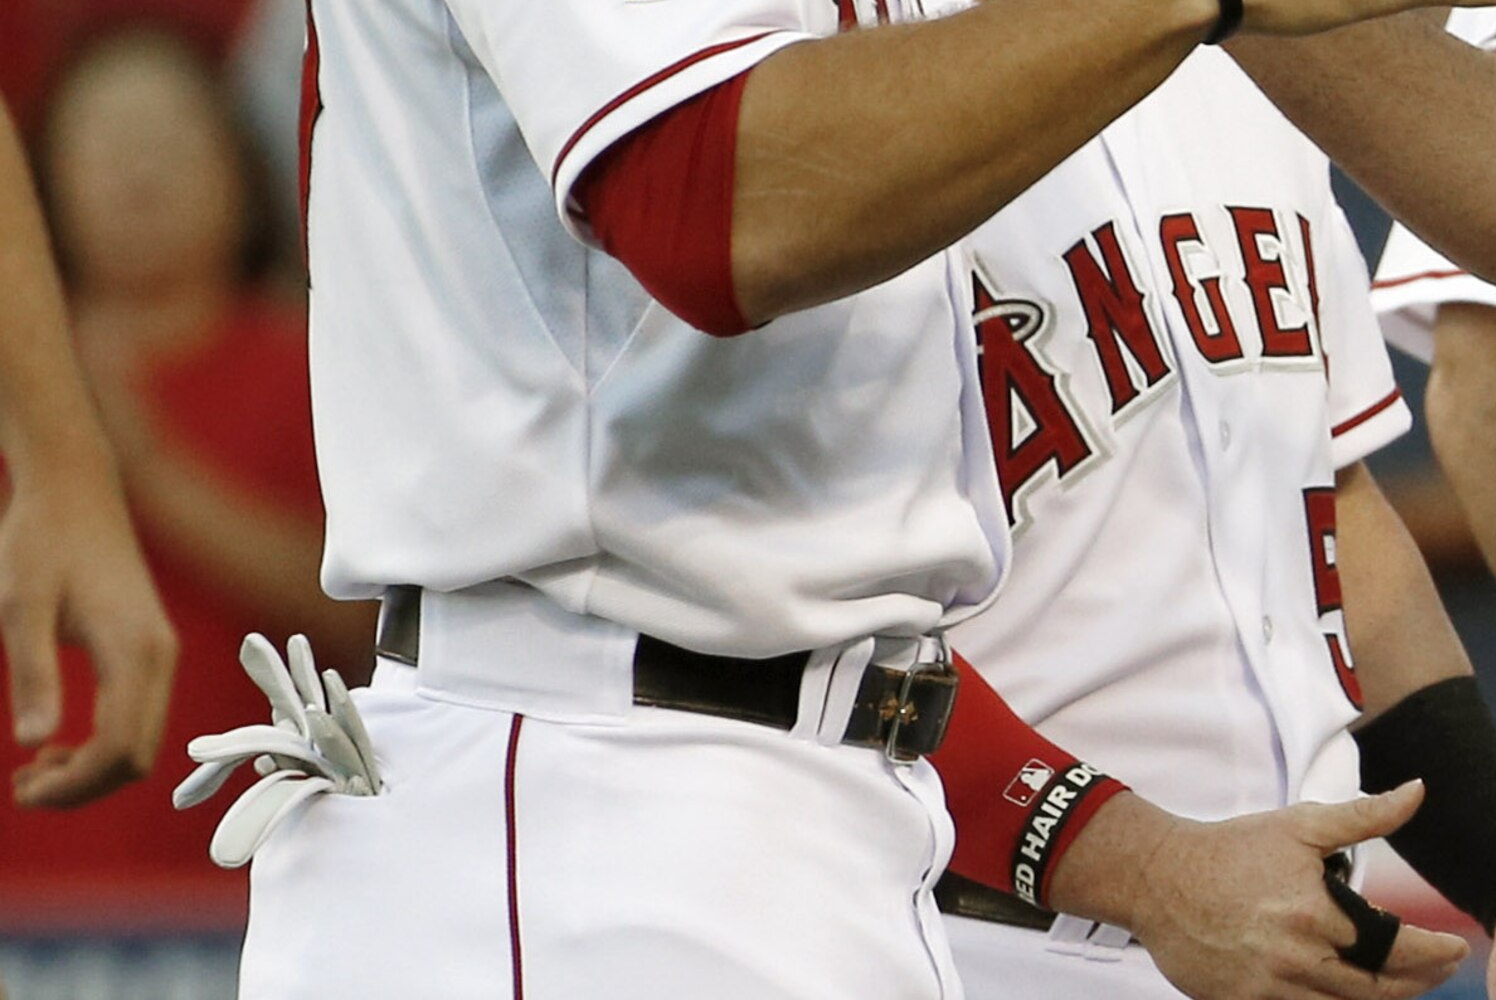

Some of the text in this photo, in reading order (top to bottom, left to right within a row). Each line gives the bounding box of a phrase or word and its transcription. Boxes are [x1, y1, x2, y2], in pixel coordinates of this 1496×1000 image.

[970, 205, 1332, 530] ANGE
[1020, 784, 1077, 861] HAIR
[1014, 862, 1037, 907] ED
